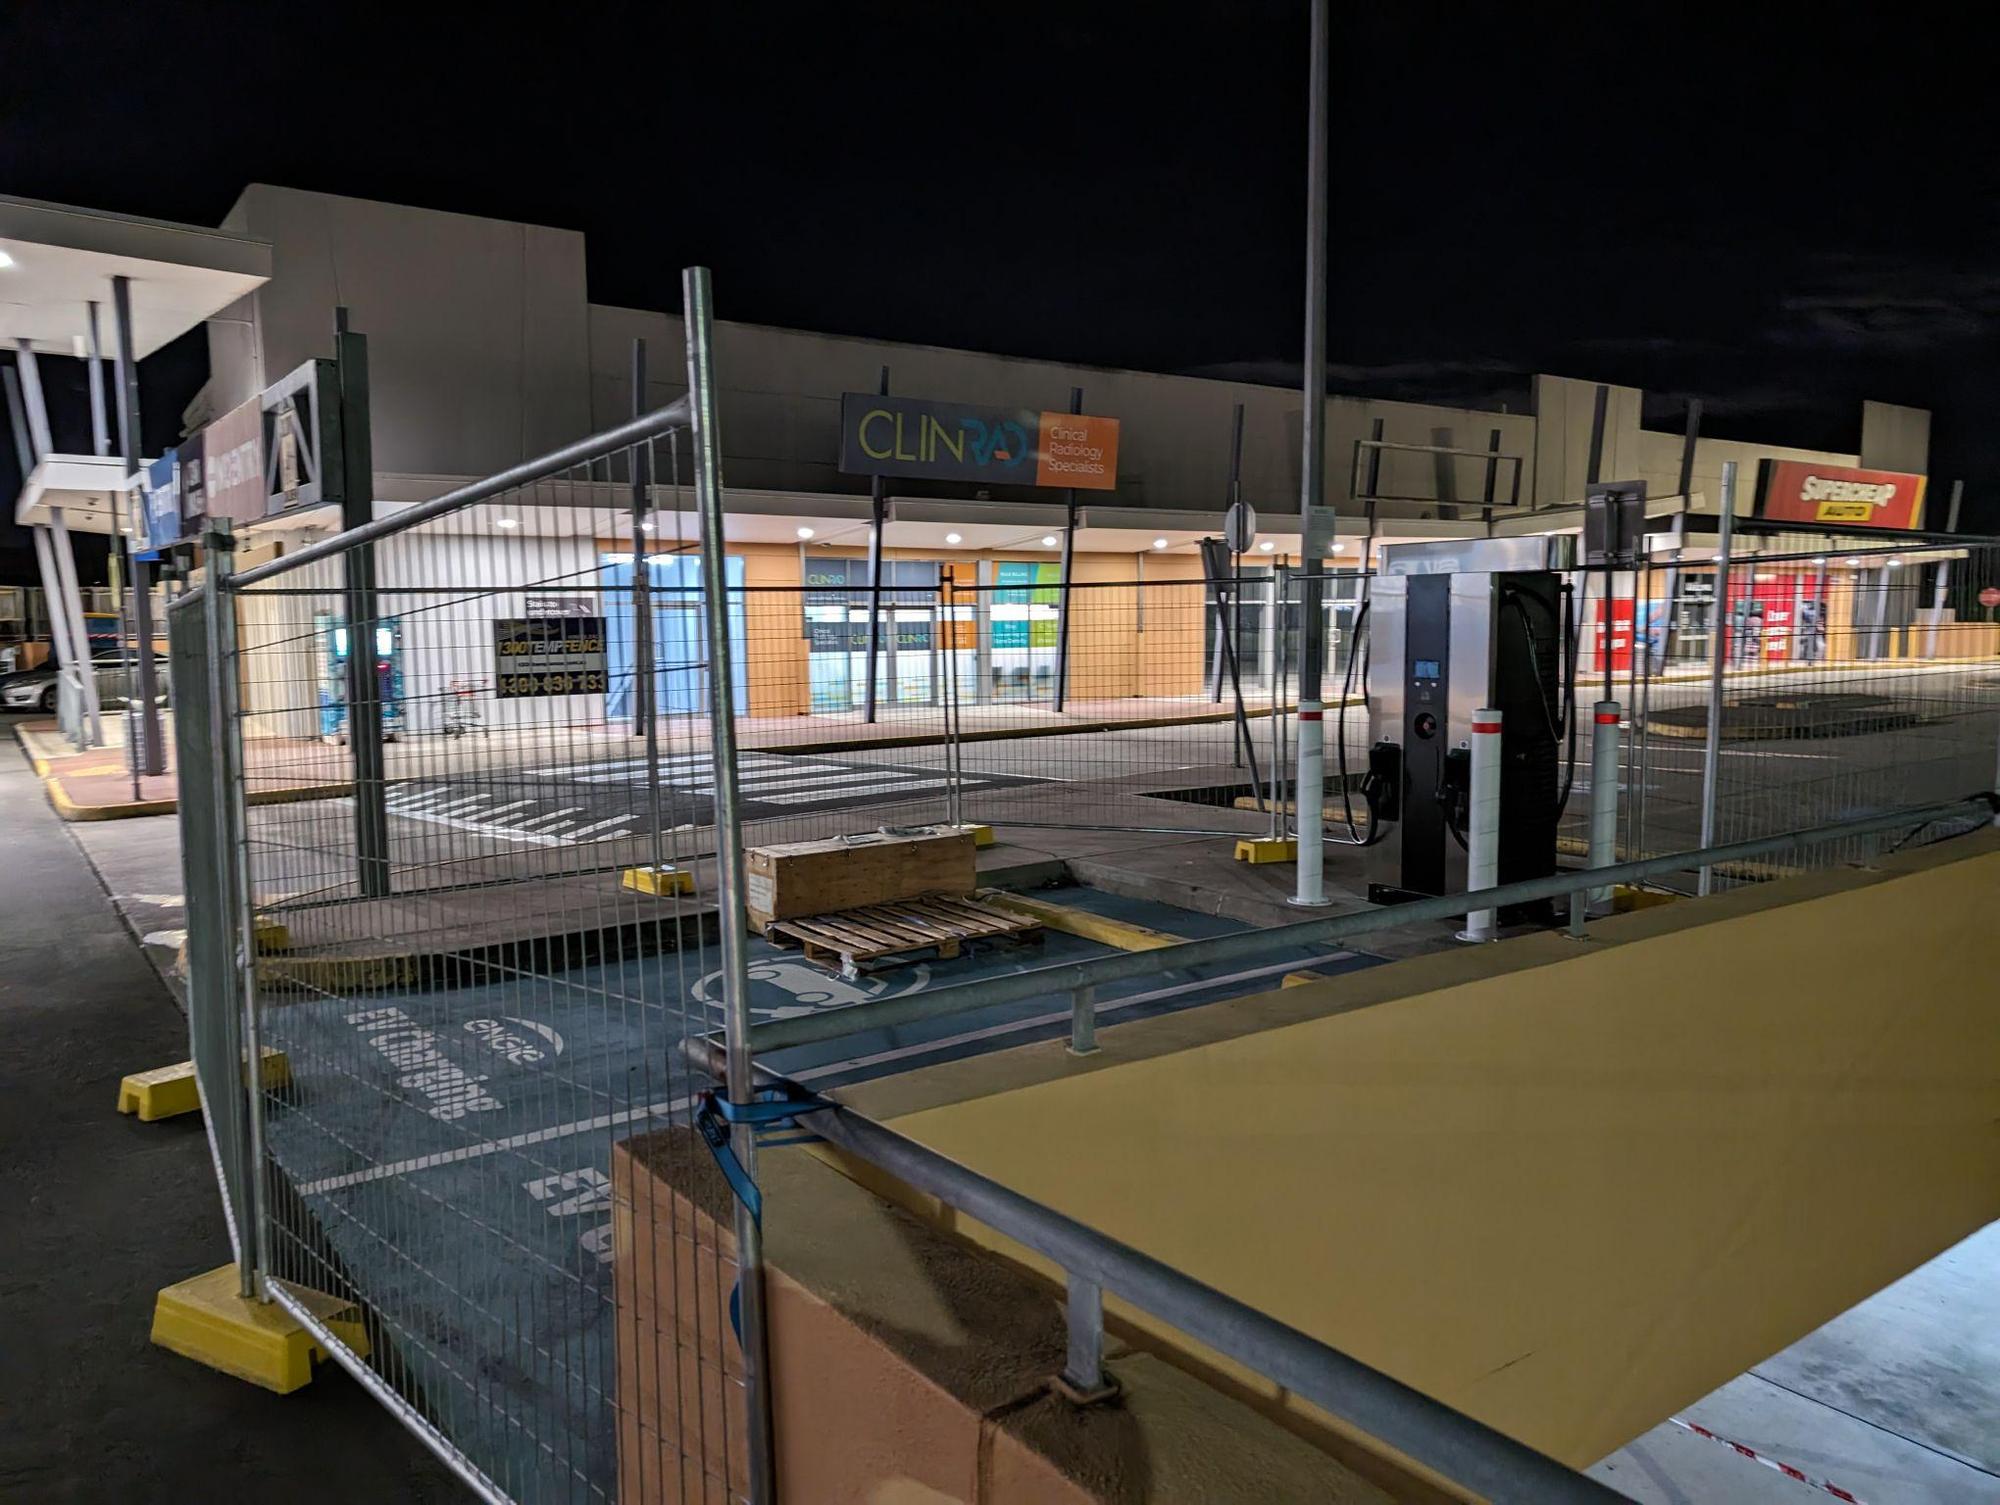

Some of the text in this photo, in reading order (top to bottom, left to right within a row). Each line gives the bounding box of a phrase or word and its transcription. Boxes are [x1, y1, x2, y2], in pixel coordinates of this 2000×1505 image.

[858, 409, 1028, 467] CLINRAD
[1050, 425, 1089, 442] Clinical
[1049, 442, 1104, 460] Radiology
[1048, 458, 1105, 475] Specialists
[368, 1027, 505, 1121] Charging
